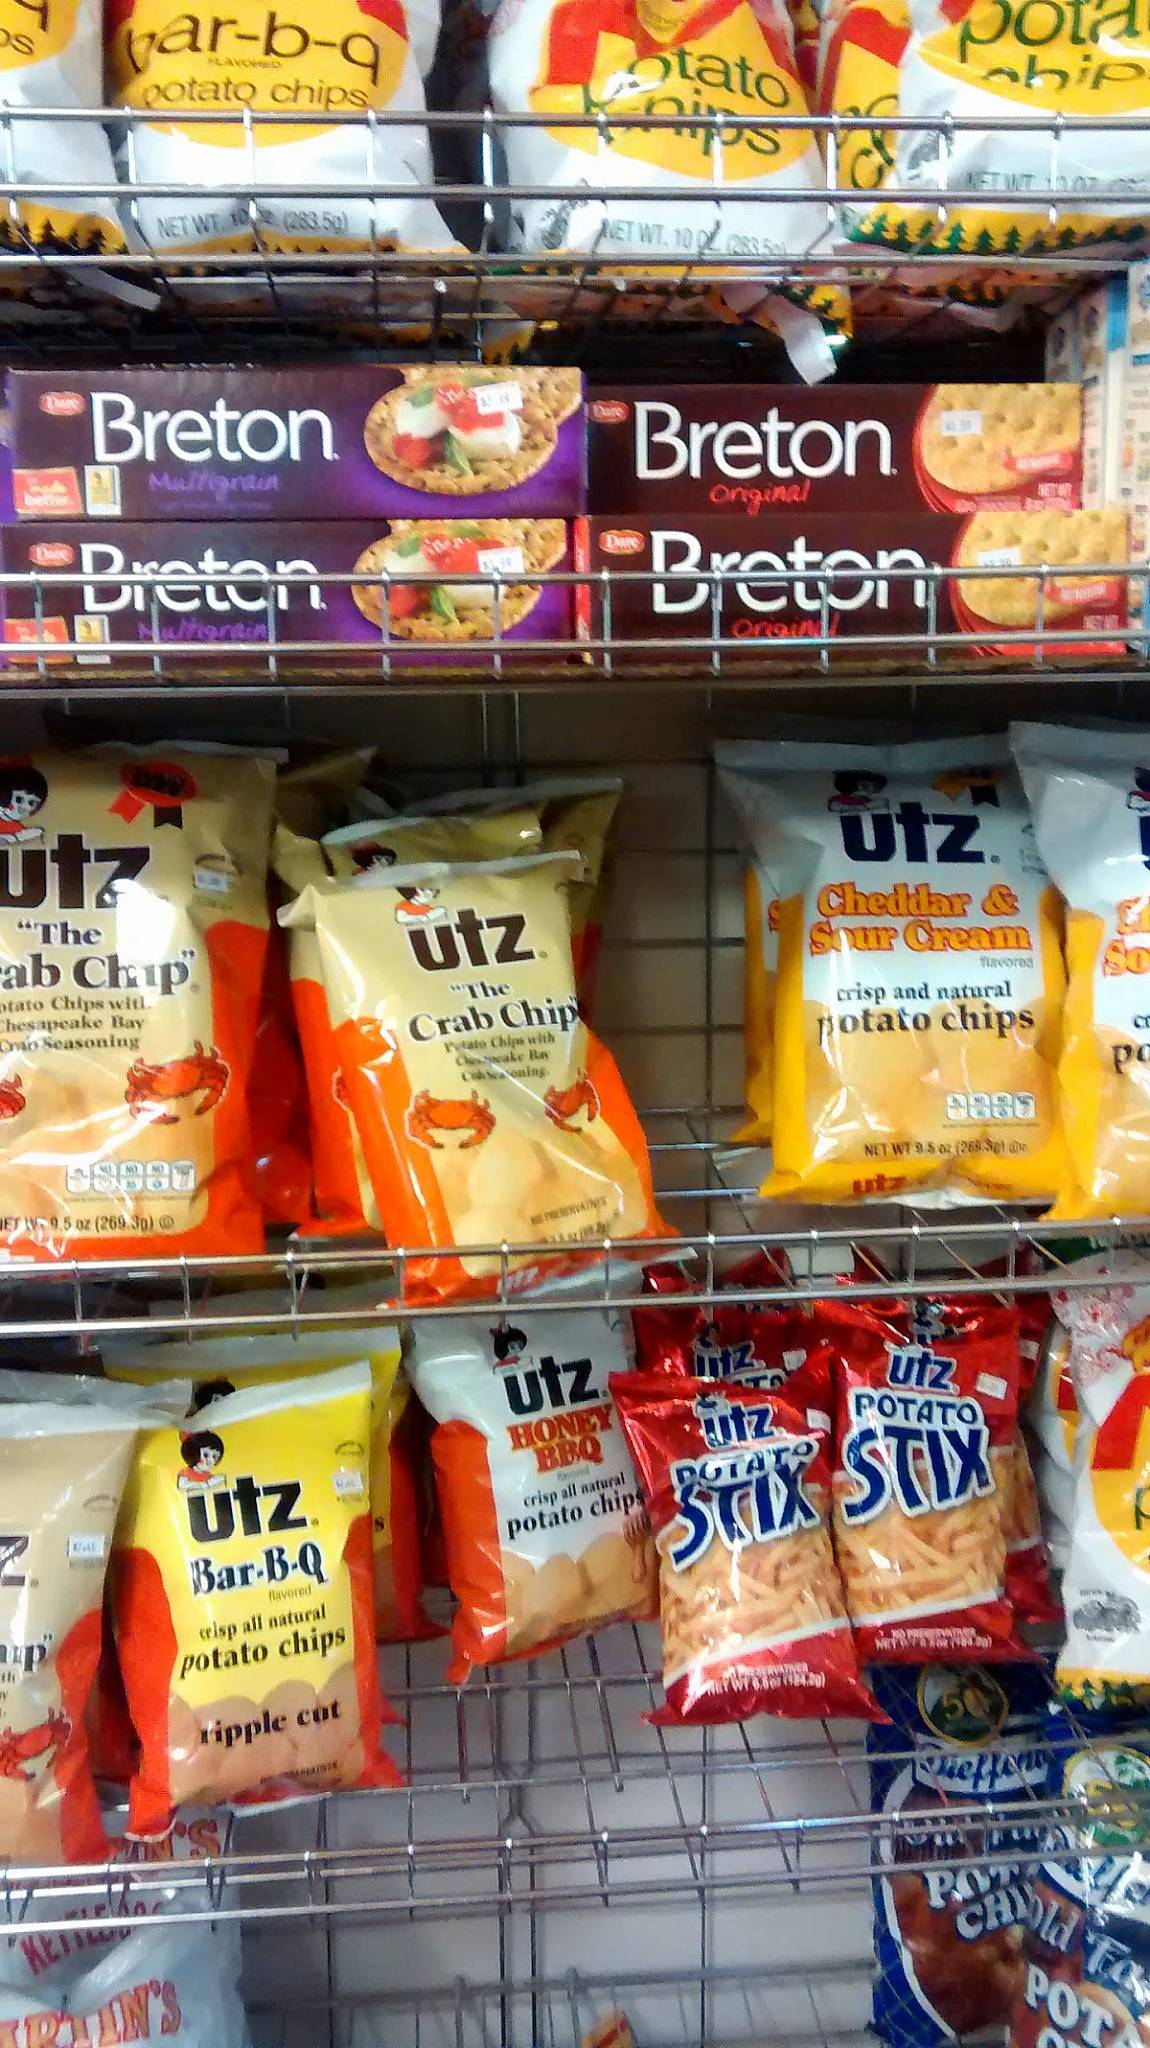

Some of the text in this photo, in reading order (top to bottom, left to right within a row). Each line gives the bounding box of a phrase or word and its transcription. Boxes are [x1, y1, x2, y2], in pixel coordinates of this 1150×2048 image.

[142, 76, 370, 111] potato chips
[157, 214, 189, 238] NET
[601, 217, 633, 242] NET
[90, 391, 334, 462] Breton
[635, 401, 891, 480] Breton
[709, 480, 810, 516] Original
[606, 534, 639, 549] Dare
[80, 543, 320, 613] Breton
[652, 531, 926, 614] Breton
[840, 801, 985, 863] utz
[817, 880, 1020, 918] Cheddar &
[407, 907, 537, 972] utz
[809, 919, 1033, 956] Sour Cream
[51, 996, 104, 1014] Chips
[836, 979, 1013, 1004] crisp and natural
[111, 1014, 144, 1031] Bay
[409, 1007, 493, 1043] Crab
[816, 1003, 1035, 1046] potato chips
[42, 1034, 140, 1053] Seasoning
[503, 1356, 600, 1415] utz
[890, 1349, 957, 1389] utz
[506, 1403, 614, 1452] HONEY
[703, 1404, 774, 1447] utz
[855, 1394, 979, 1426] POTATO
[533, 1432, 606, 1475] BBQ
[845, 1425, 991, 1518] STIX
[522, 1471, 626, 1508] crisp all natural
[187, 1477, 308, 1543] utz
[506, 1501, 583, 1540] potato
[672, 1460, 818, 1566] STIX
[190, 1541, 329, 1597] Bar-B-Q
[267, 1584, 312, 1601] flavored
[199, 1602, 327, 1641] crisp all natural
[179, 1626, 347, 1680] potato chips
[199, 1699, 343, 1748] ripple cut
